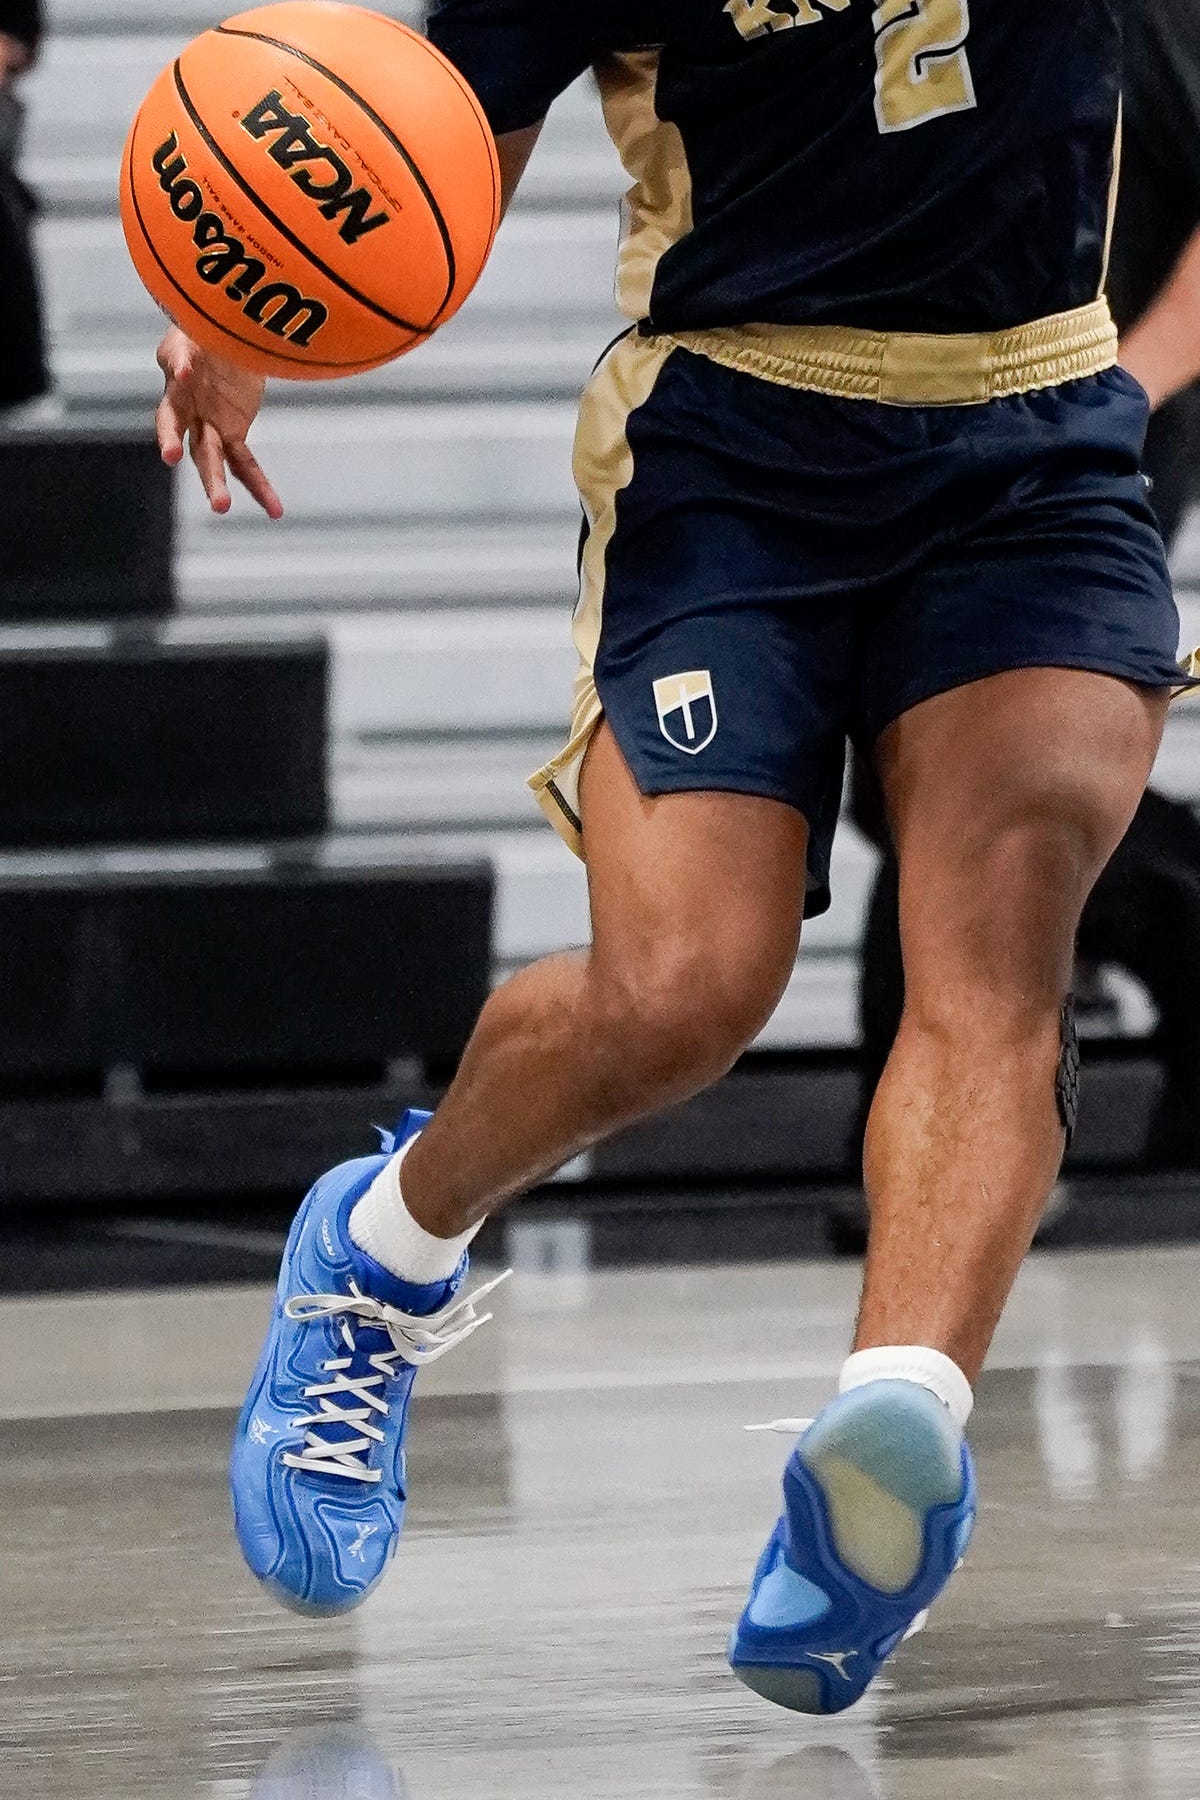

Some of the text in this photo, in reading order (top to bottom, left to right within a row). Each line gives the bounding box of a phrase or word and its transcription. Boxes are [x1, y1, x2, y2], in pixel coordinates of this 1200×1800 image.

[150, 128, 328, 347] Wilson
[239, 88, 391, 246] NCAA
[246, 234, 284, 269] INDOOR
